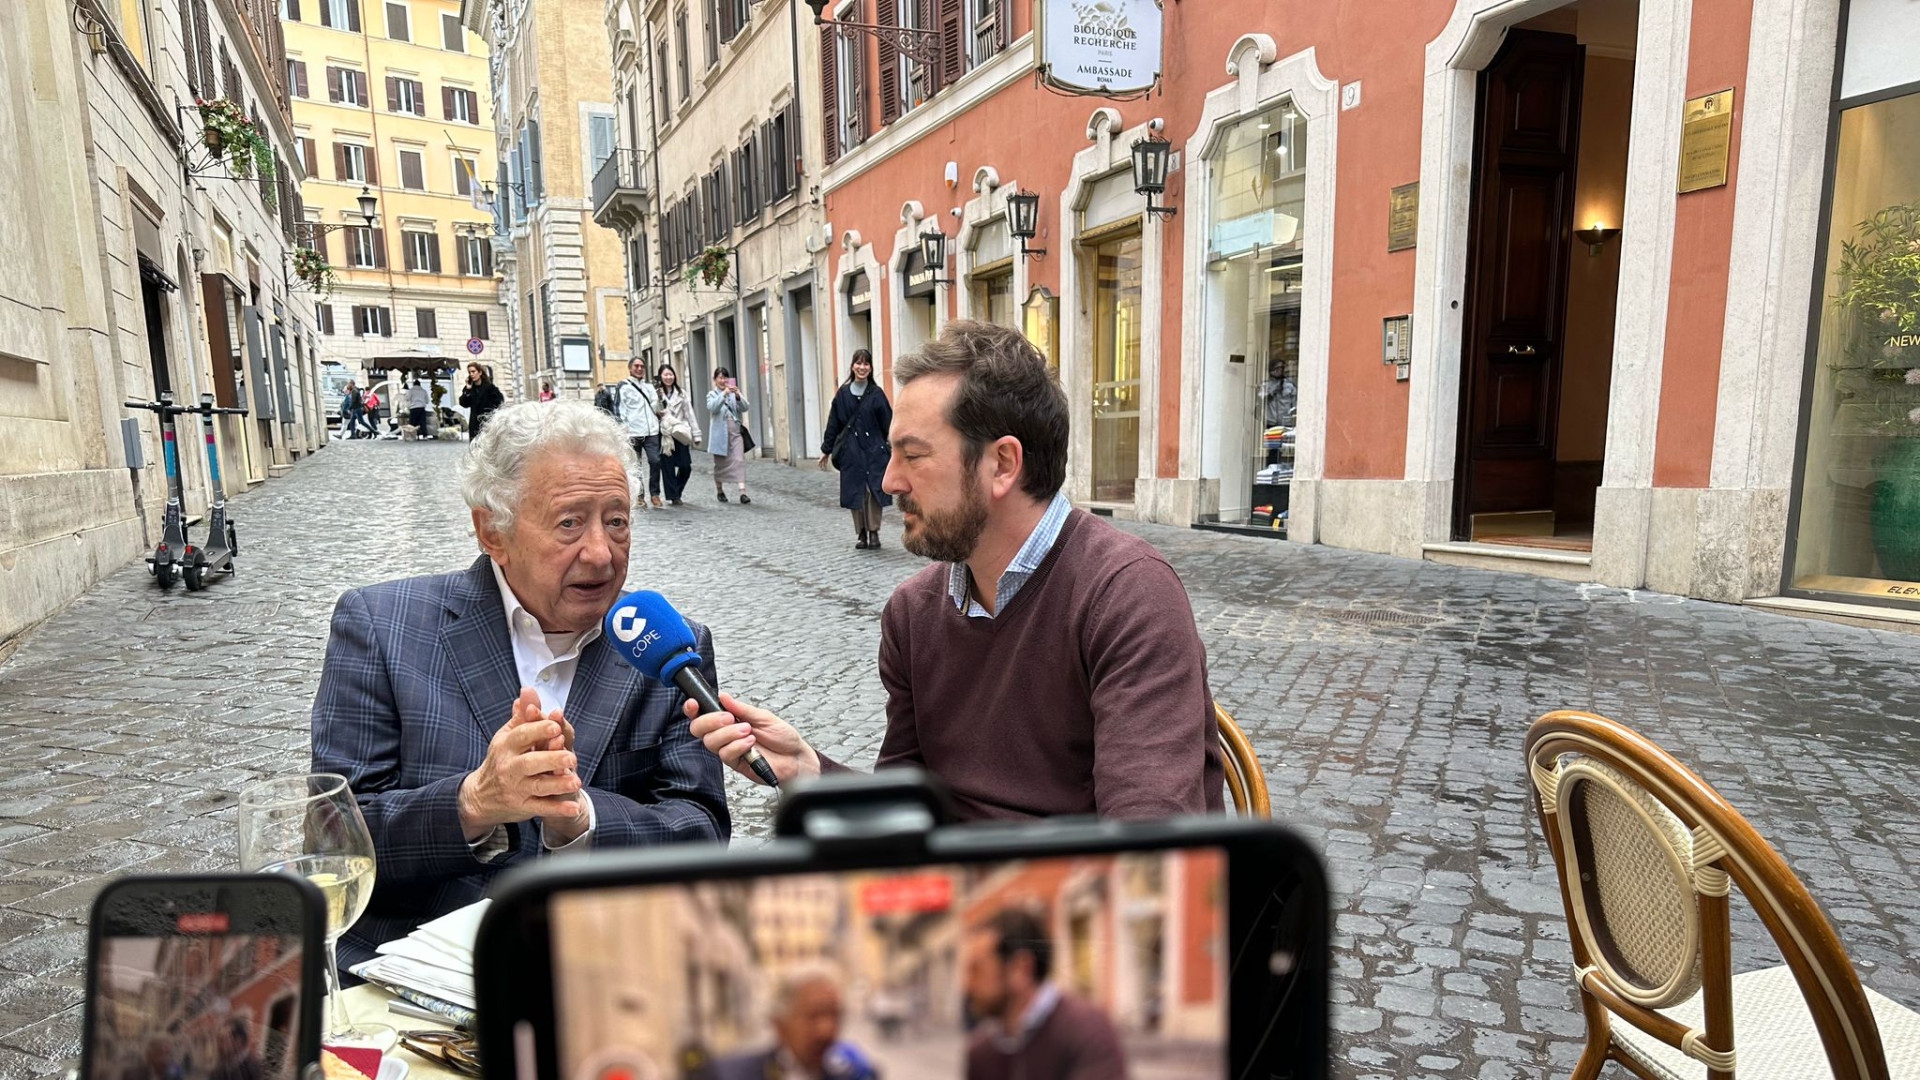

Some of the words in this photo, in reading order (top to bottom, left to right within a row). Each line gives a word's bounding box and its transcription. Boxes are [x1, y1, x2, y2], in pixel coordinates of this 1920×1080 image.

[1073, 24, 1137, 39] BIOLOGIQUE
[1073, 36, 1137, 50] RECHERCHE
[1077, 65, 1133, 78] AMBASSADE
[1346, 86, 1355, 106] 9
[1890, 334, 1920, 347] NEW
[632, 629, 661, 658] COPE
